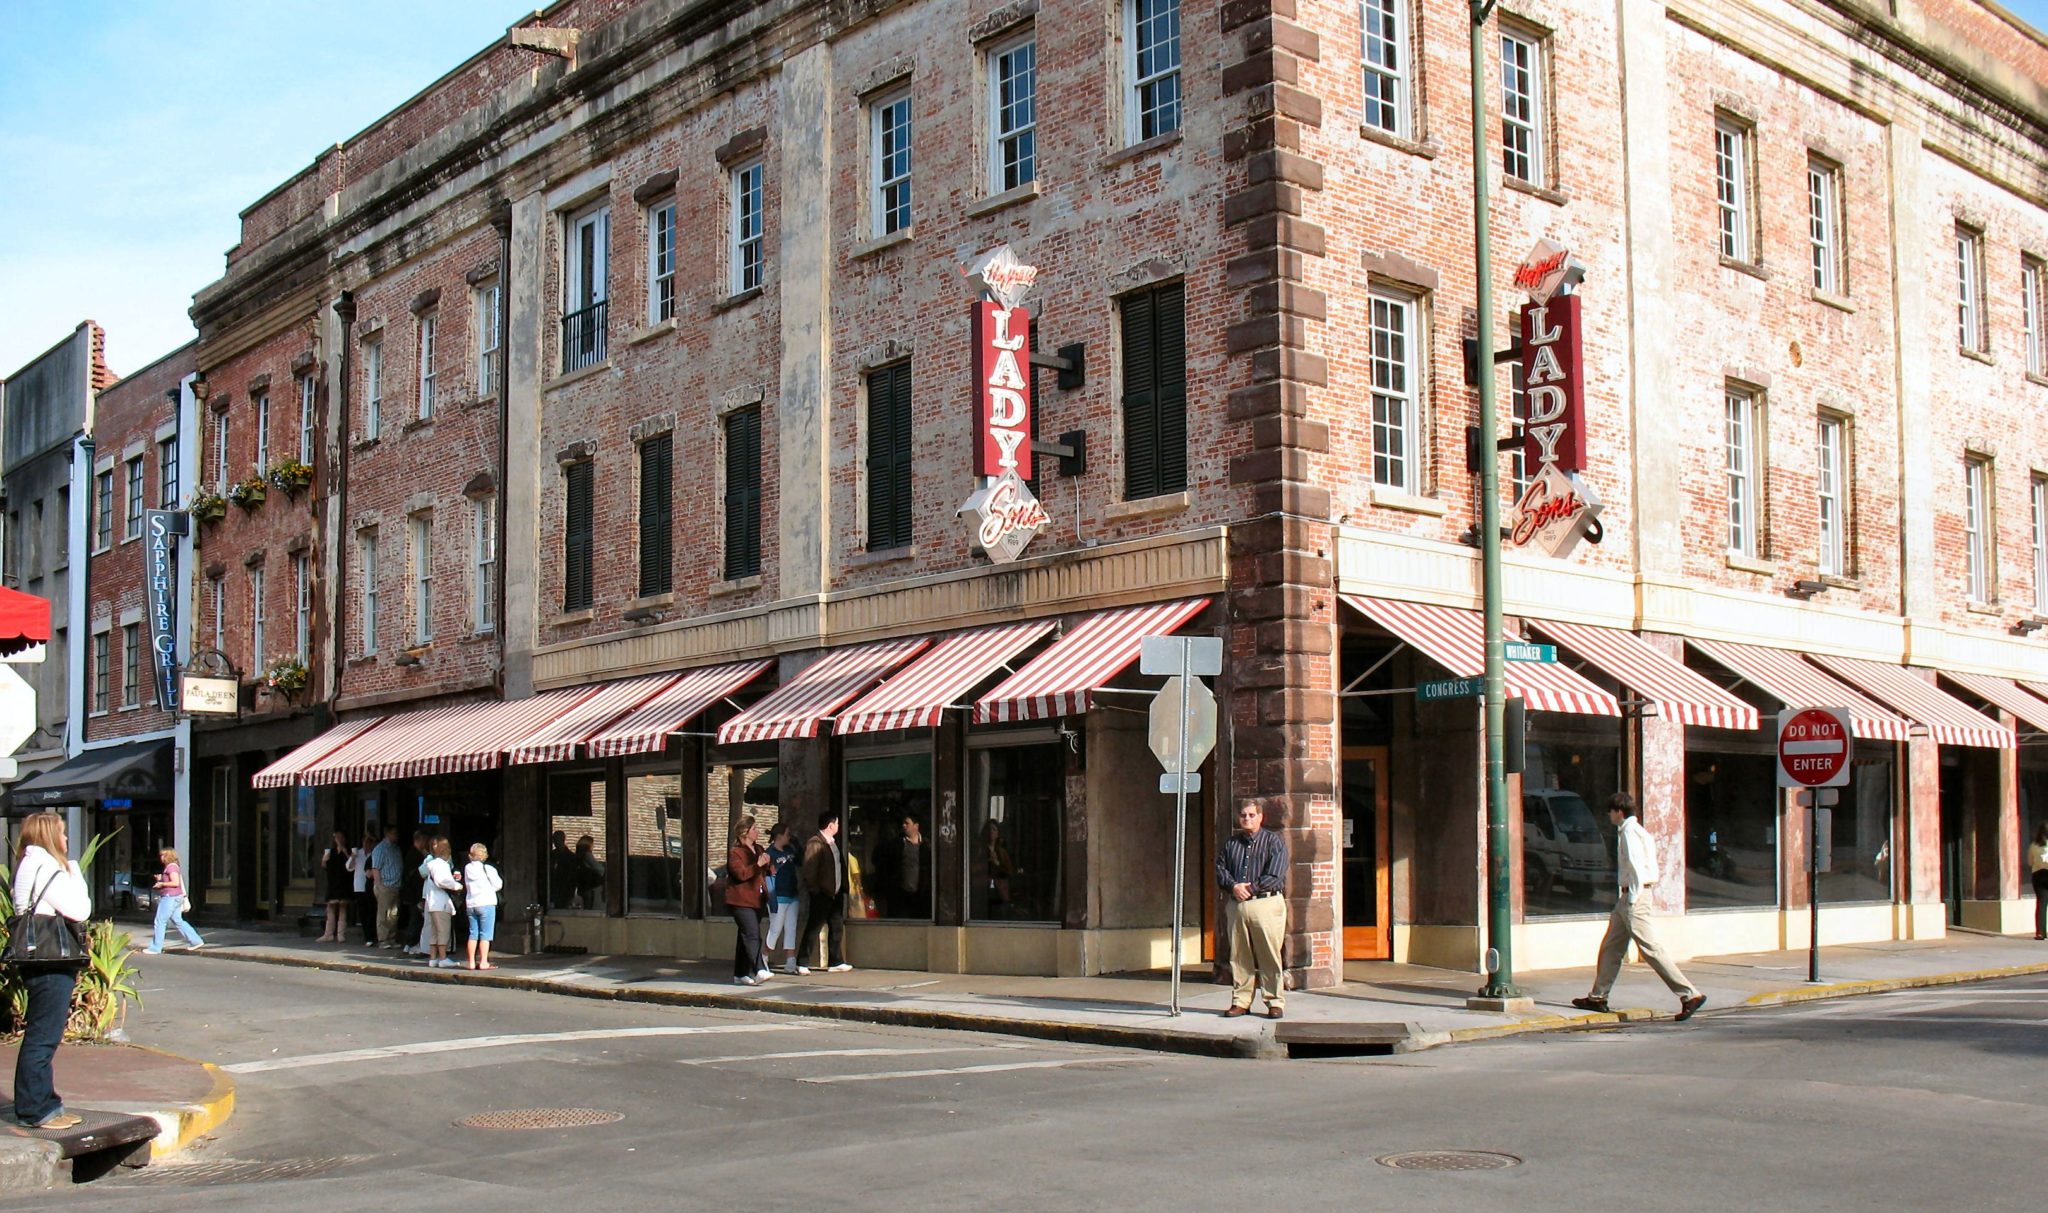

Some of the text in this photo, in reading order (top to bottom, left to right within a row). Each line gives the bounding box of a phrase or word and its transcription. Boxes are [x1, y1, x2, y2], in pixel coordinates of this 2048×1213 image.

[989, 313, 1027, 468] LADY
[1528, 307, 1567, 462] LADY
[979, 481, 1051, 548] Sons
[1511, 480, 1584, 547] Sons
[1506, 644, 1541, 661] WHITAKER
[211, 690, 236, 699] DEEN
[1425, 680, 1470, 698] CONGRESS
[1789, 724, 1837, 737] DO NOT
[1793, 758, 1832, 770] ENTER
